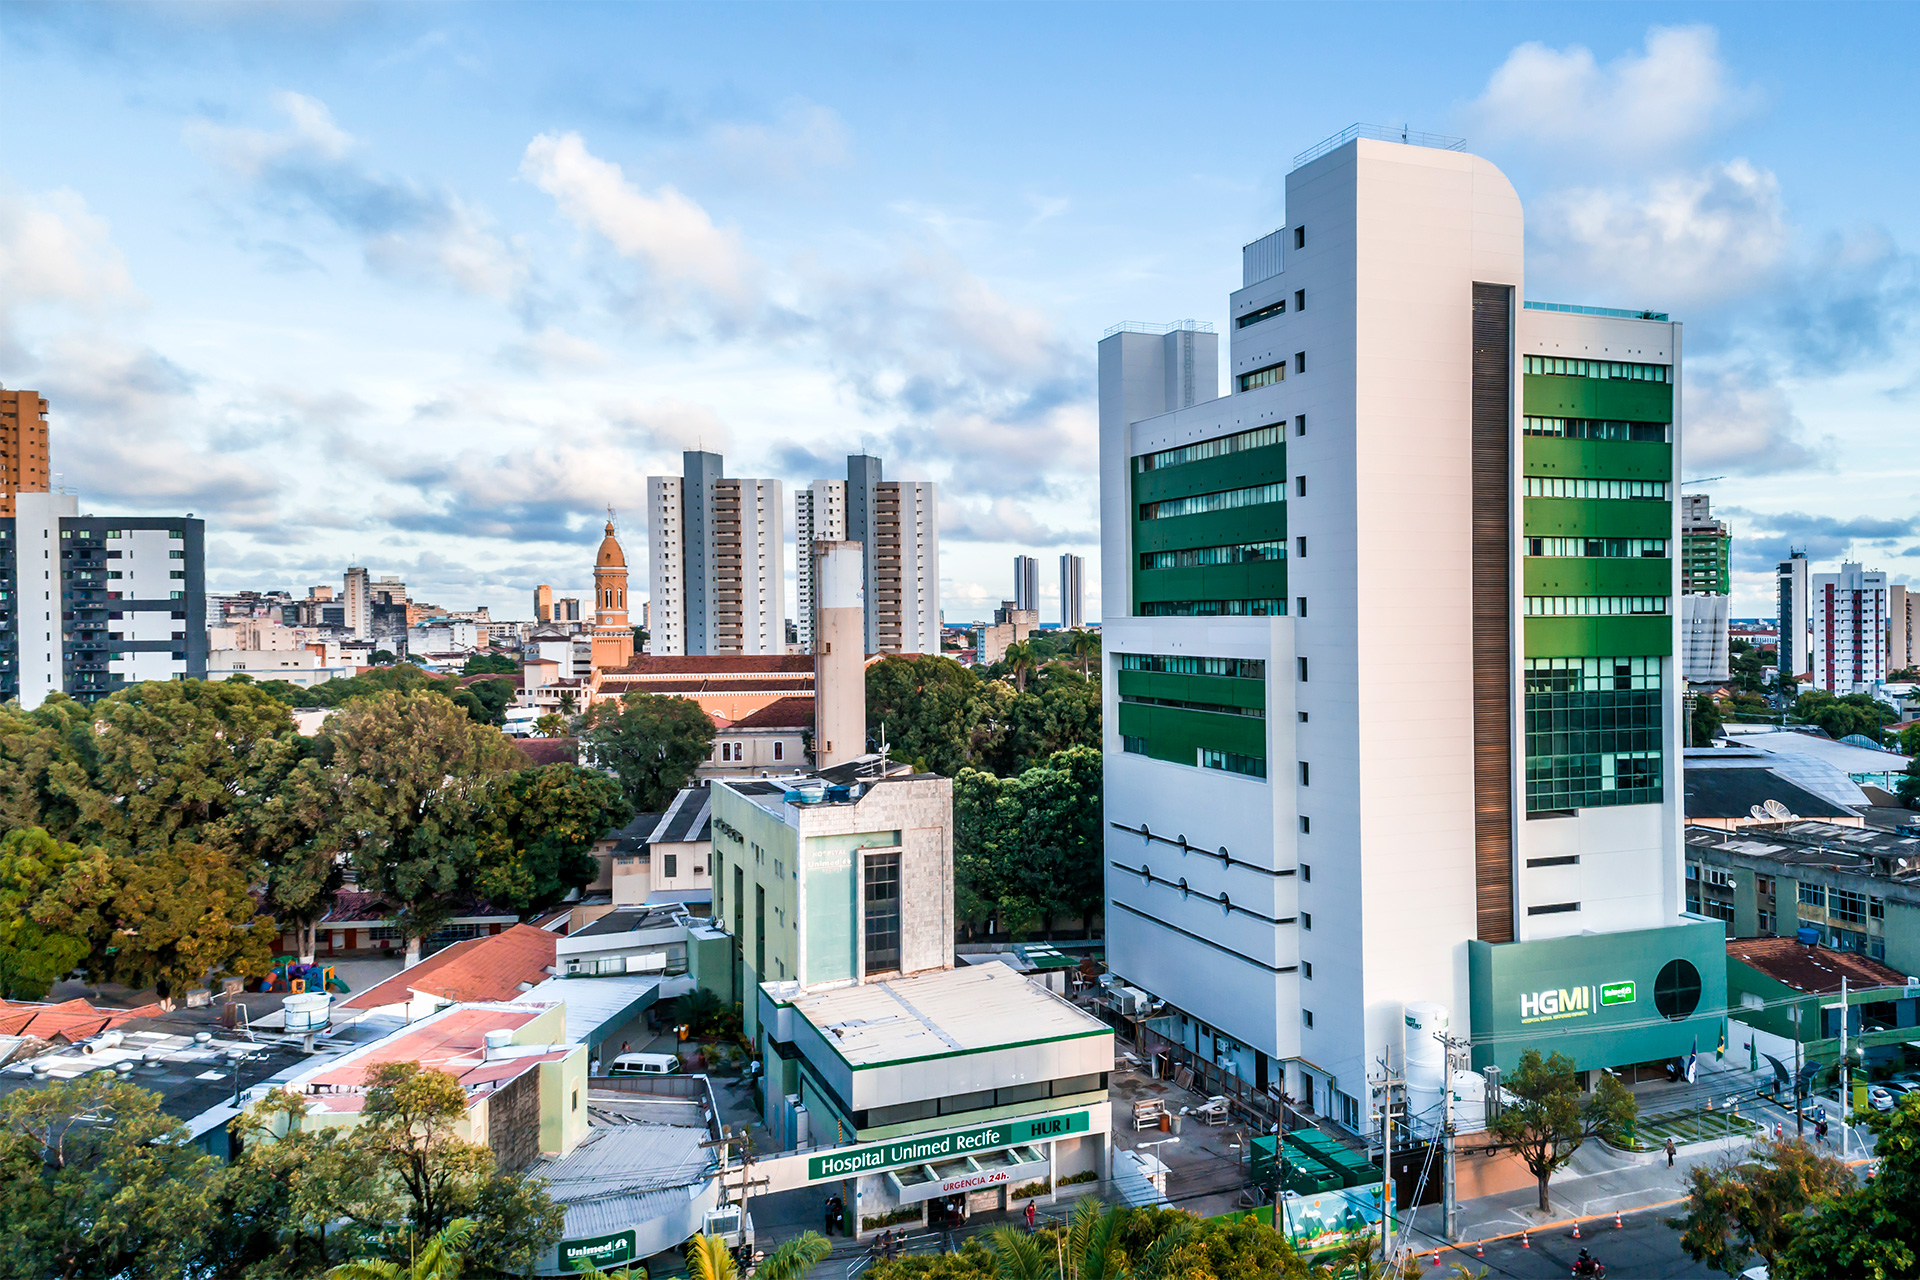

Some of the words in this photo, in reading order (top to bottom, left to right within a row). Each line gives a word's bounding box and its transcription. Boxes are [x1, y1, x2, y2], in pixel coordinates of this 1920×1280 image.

[807, 858, 840, 868] Unimed
[1520, 986, 1589, 1017] HGMI
[1031, 1120, 1061, 1136] HUR
[1066, 1118, 1070, 1130] I
[822, 1148, 885, 1174] Hospital
[892, 1137, 950, 1161] Unimed
[957, 1129, 1000, 1150] Recife
[567, 1241, 612, 1256] Unimed
